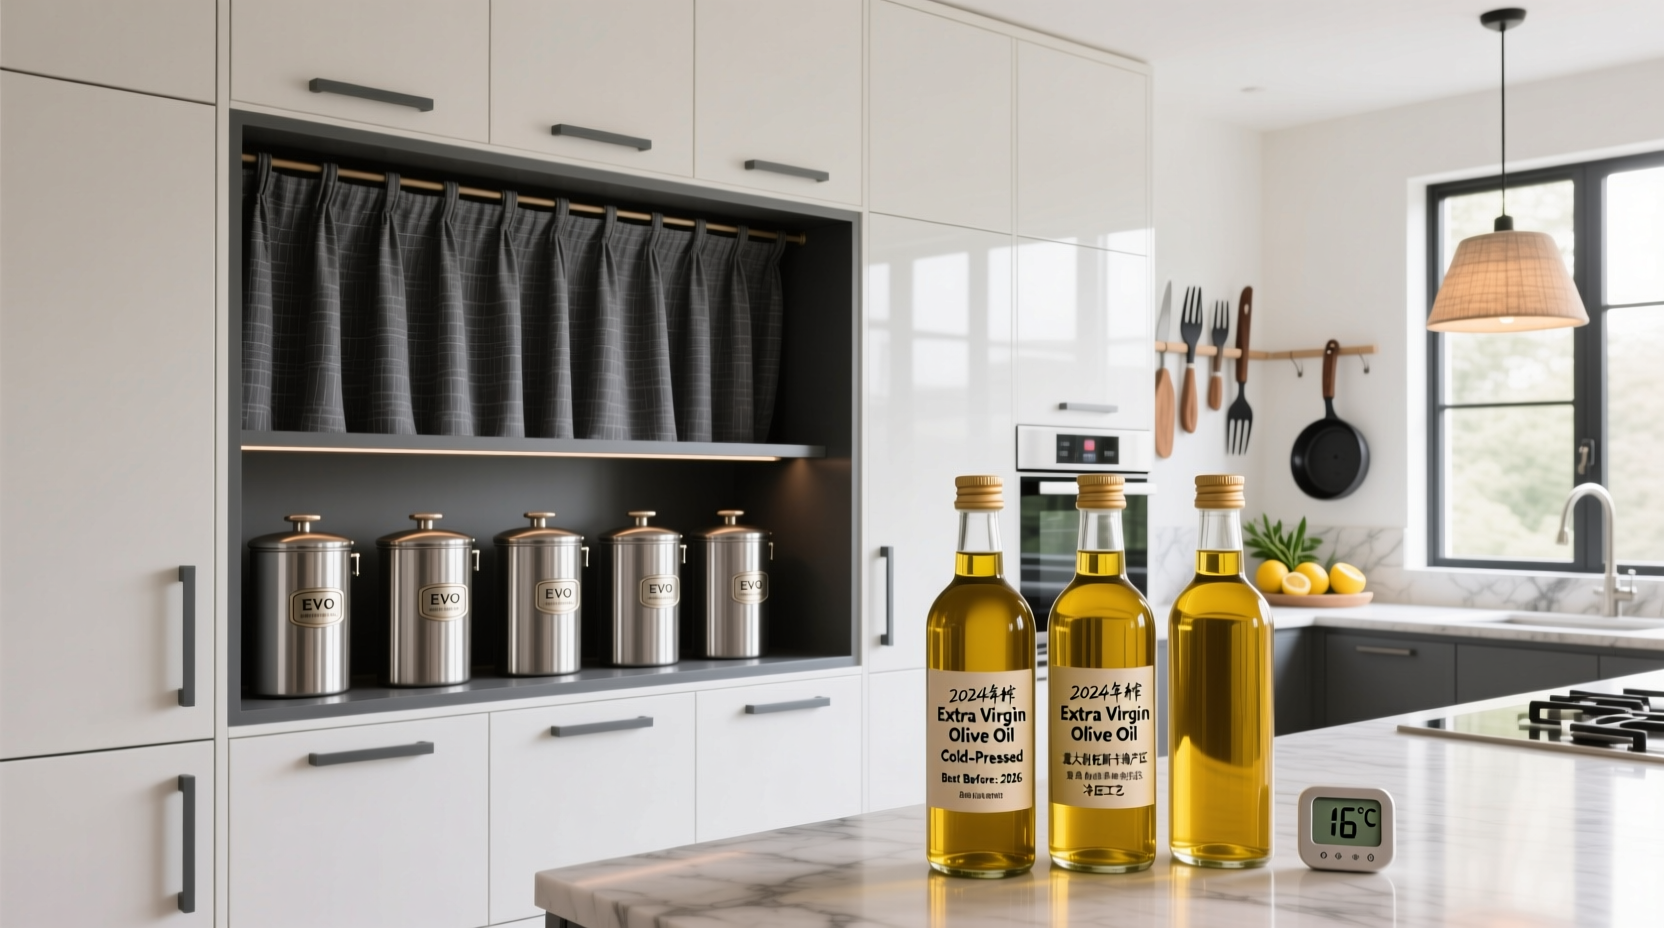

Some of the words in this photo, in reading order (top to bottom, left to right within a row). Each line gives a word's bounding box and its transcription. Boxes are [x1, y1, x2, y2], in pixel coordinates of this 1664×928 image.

[649, 583, 673, 594] EVO
[740, 580, 763, 591] EVO
[430, 593, 460, 605] EVO
[545, 588, 572, 600] EVO
[302, 598, 335, 611] EVO
[937, 706, 976, 723] Extra
[980, 706, 1026, 727] Virgin
[1061, 705, 1102, 722] Extra
[1105, 704, 1150, 725] Virgin
[949, 727, 989, 743] Olive
[993, 727, 1015, 743] Oil
[1071, 725, 1112, 742] Olive
[1116, 725, 1137, 742] Oil
[941, 748, 1023, 764] Cold-Pressed
[1000, 772, 1023, 784] 2026
